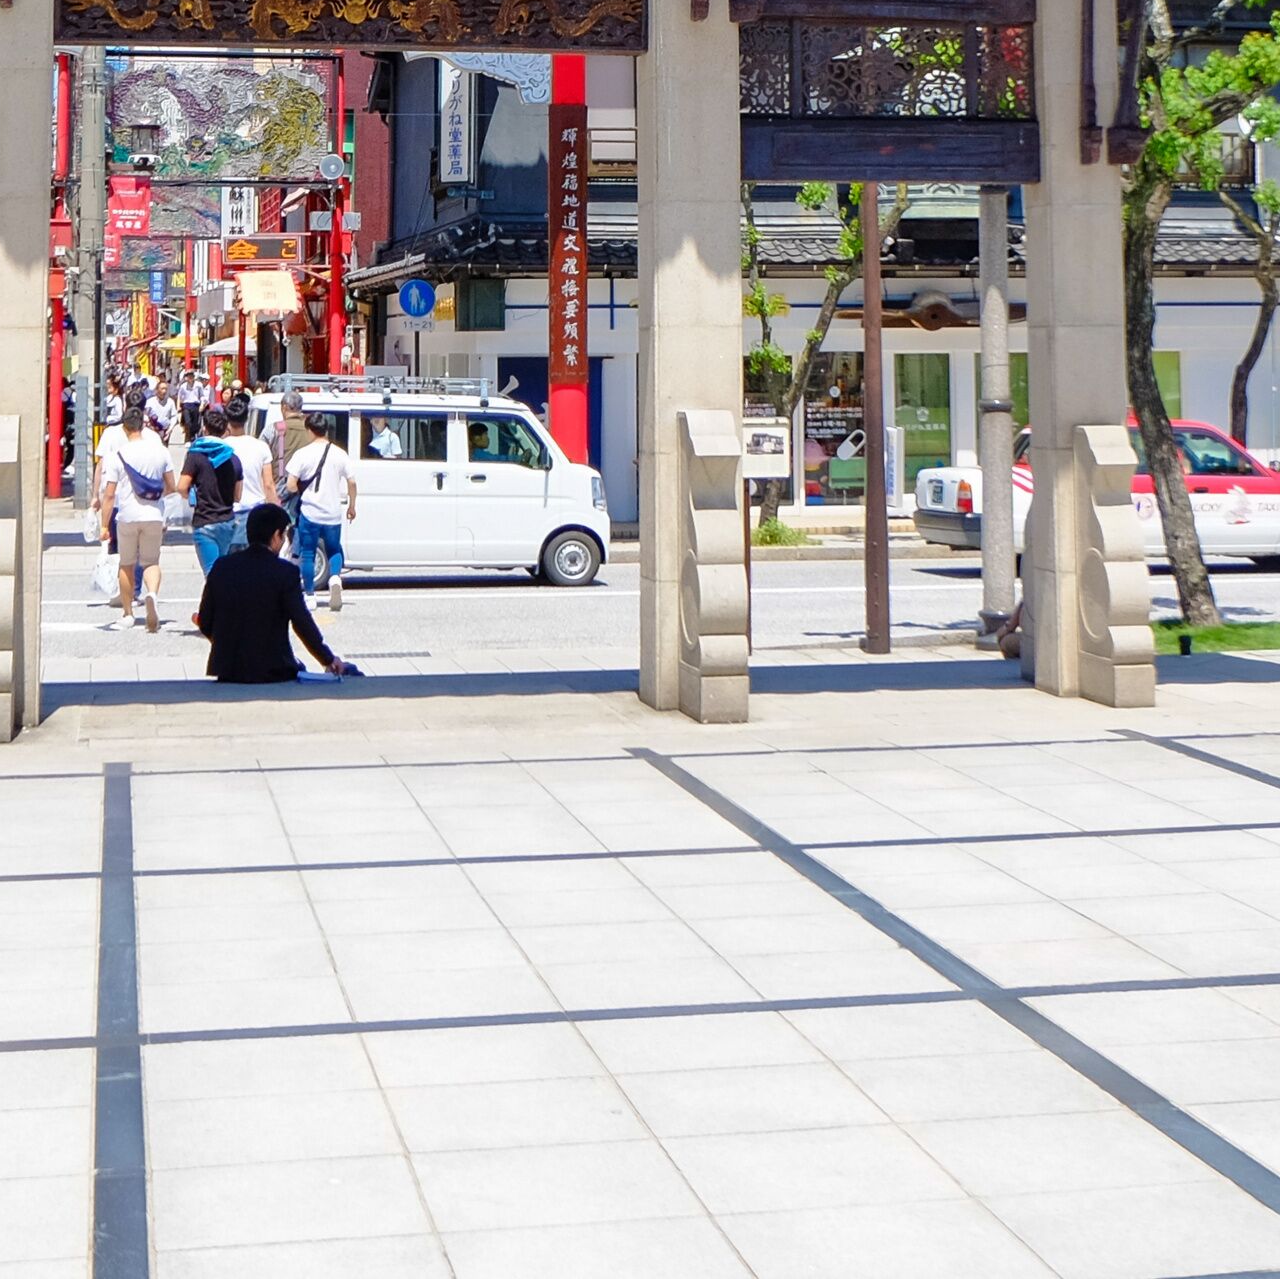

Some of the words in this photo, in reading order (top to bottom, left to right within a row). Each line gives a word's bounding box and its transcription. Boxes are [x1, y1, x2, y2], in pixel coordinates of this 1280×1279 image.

[448, 67, 463, 175] つりがね堂薬局
